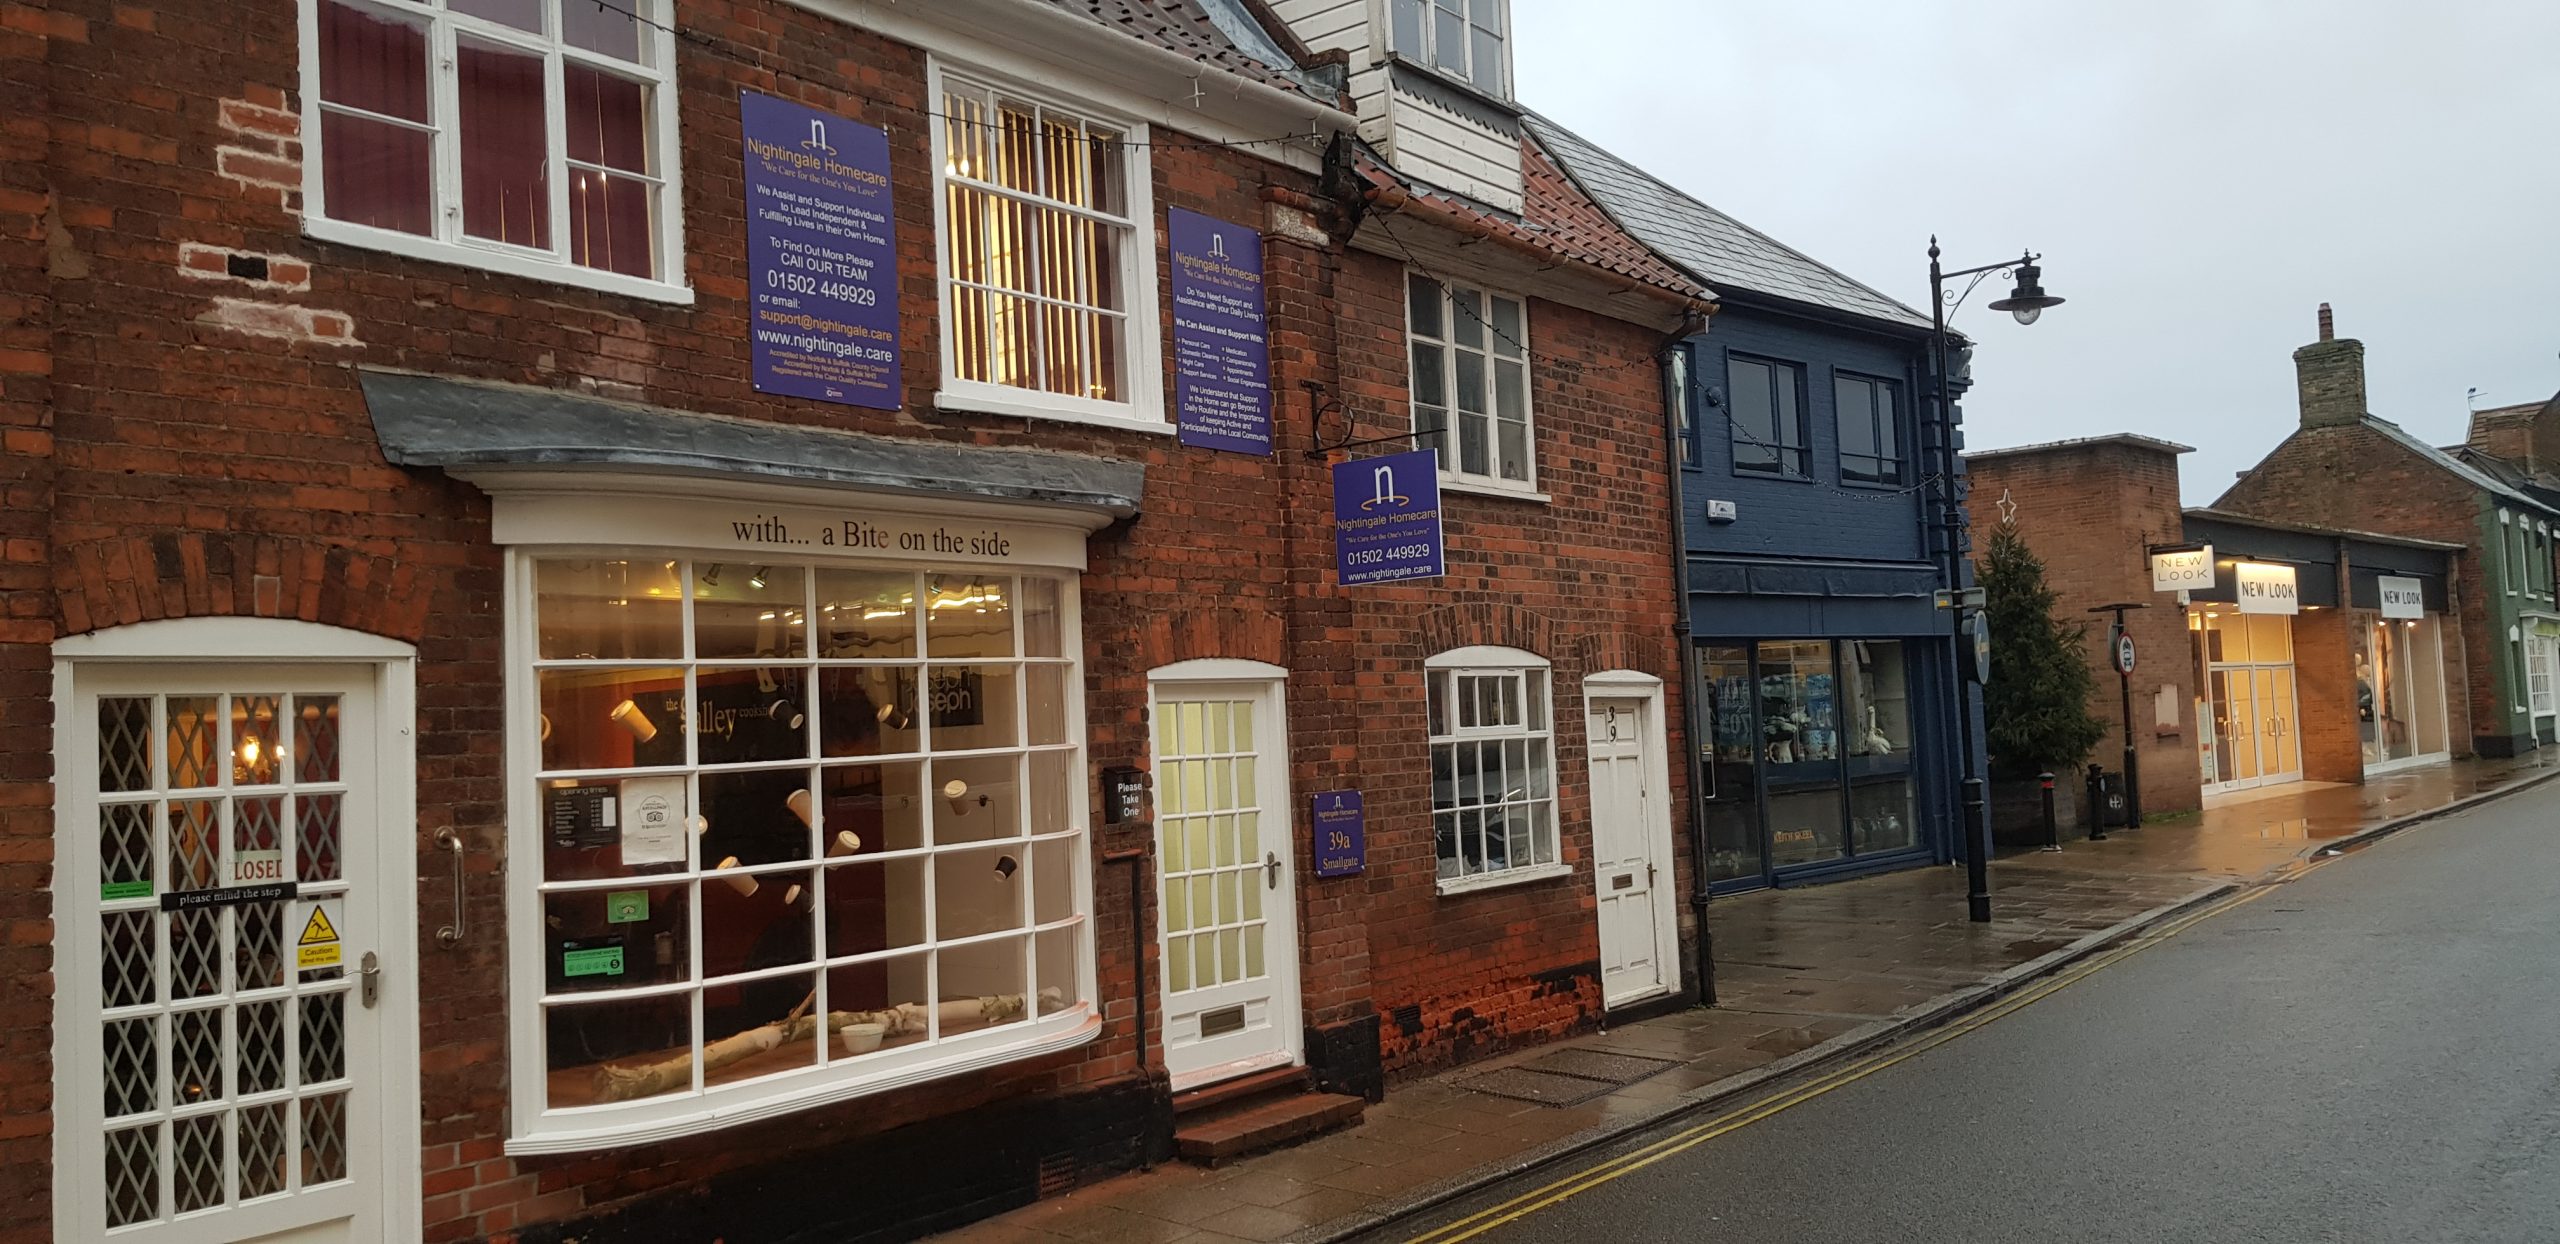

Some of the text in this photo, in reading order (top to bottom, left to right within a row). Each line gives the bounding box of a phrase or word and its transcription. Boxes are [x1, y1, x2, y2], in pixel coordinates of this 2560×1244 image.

[747, 137, 887, 187] Nightingale Homecare
[778, 165, 796, 178] Care
[798, 169, 808, 181] for
[810, 173, 821, 184] the
[843, 181, 856, 193] You
[756, 184, 885, 223] We Assist and Support Individuals
[781, 202, 867, 230] to Lead Independent &
[759, 208, 887, 246] Fulfilling Lives in their Own Home.
[770, 236, 874, 268] To Find Out More Please
[806, 258, 833, 274] OUR
[836, 263, 868, 282] TEAM
[1175, 250, 1261, 283] Nightingale Homecare
[768, 269, 876, 306] 01502 449929
[759, 294, 800, 309] or email:
[1186, 286, 1253, 309] Do You Need Support and
[1176, 295, 1259, 322] Assistance with your Daily Living
[760, 310, 893, 342] support@nightingale.care
[1176, 317, 1185, 327] We
[1186, 320, 1197, 329] Can
[1198, 322, 1216, 333] Assist
[1228, 329, 1249, 340] Support
[758, 329, 893, 362] www.nightingale.care
[1182, 338, 1200, 347] Personal
[769, 349, 798, 360] Accredited
[800, 354, 807, 362] by
[1202, 352, 1220, 362] Cleaning
[1226, 347, 1247, 357] Medication
[784, 359, 812, 370] Accredited
[813, 364, 820, 372] by
[1182, 358, 1204, 368] Night Care
[824, 373, 838, 381] Care
[1183, 368, 1199, 376] Support
[1189, 384, 1259, 403] We Understand that Support
[1185, 403, 1198, 413] Daily
[1198, 405, 1218, 415] Routine
[1229, 411, 1238, 419] the
[1195, 395, 1256, 412] the Home can go Beyond
[1200, 415, 1206, 423] of
[1206, 416, 1226, 427] keeping
[1226, 420, 1241, 429] Active
[1181, 422, 1269, 444] Participating in the Local Community
[1337, 509, 1437, 532] Nightingale Homecare
[732, 515, 1010, 557] with... a Bite on the side
[1357, 534, 1369, 542] Care
[1402, 529, 1413, 537] You
[1347, 543, 1430, 566] 01502 449929
[2161, 555, 2203, 568] NEW
[1347, 564, 1432, 582] www.nightingale.care
[2158, 569, 2208, 582] LOOK
[2241, 581, 2295, 599] NEW LOOK
[2384, 590, 2421, 606] NEW LOOK
[666, 697, 678, 711] the
[560, 786, 608, 796] opening times
[1117, 782, 1142, 793] Please
[1122, 794, 1139, 805] Take
[1123, 807, 1140, 817] One
[1329, 830, 1350, 851] 39a
[1323, 856, 1358, 870] Smallgate
[180, 888, 282, 906] please mind the step
[305, 948, 333, 956] Caution
[612, 960, 618, 968] 5
